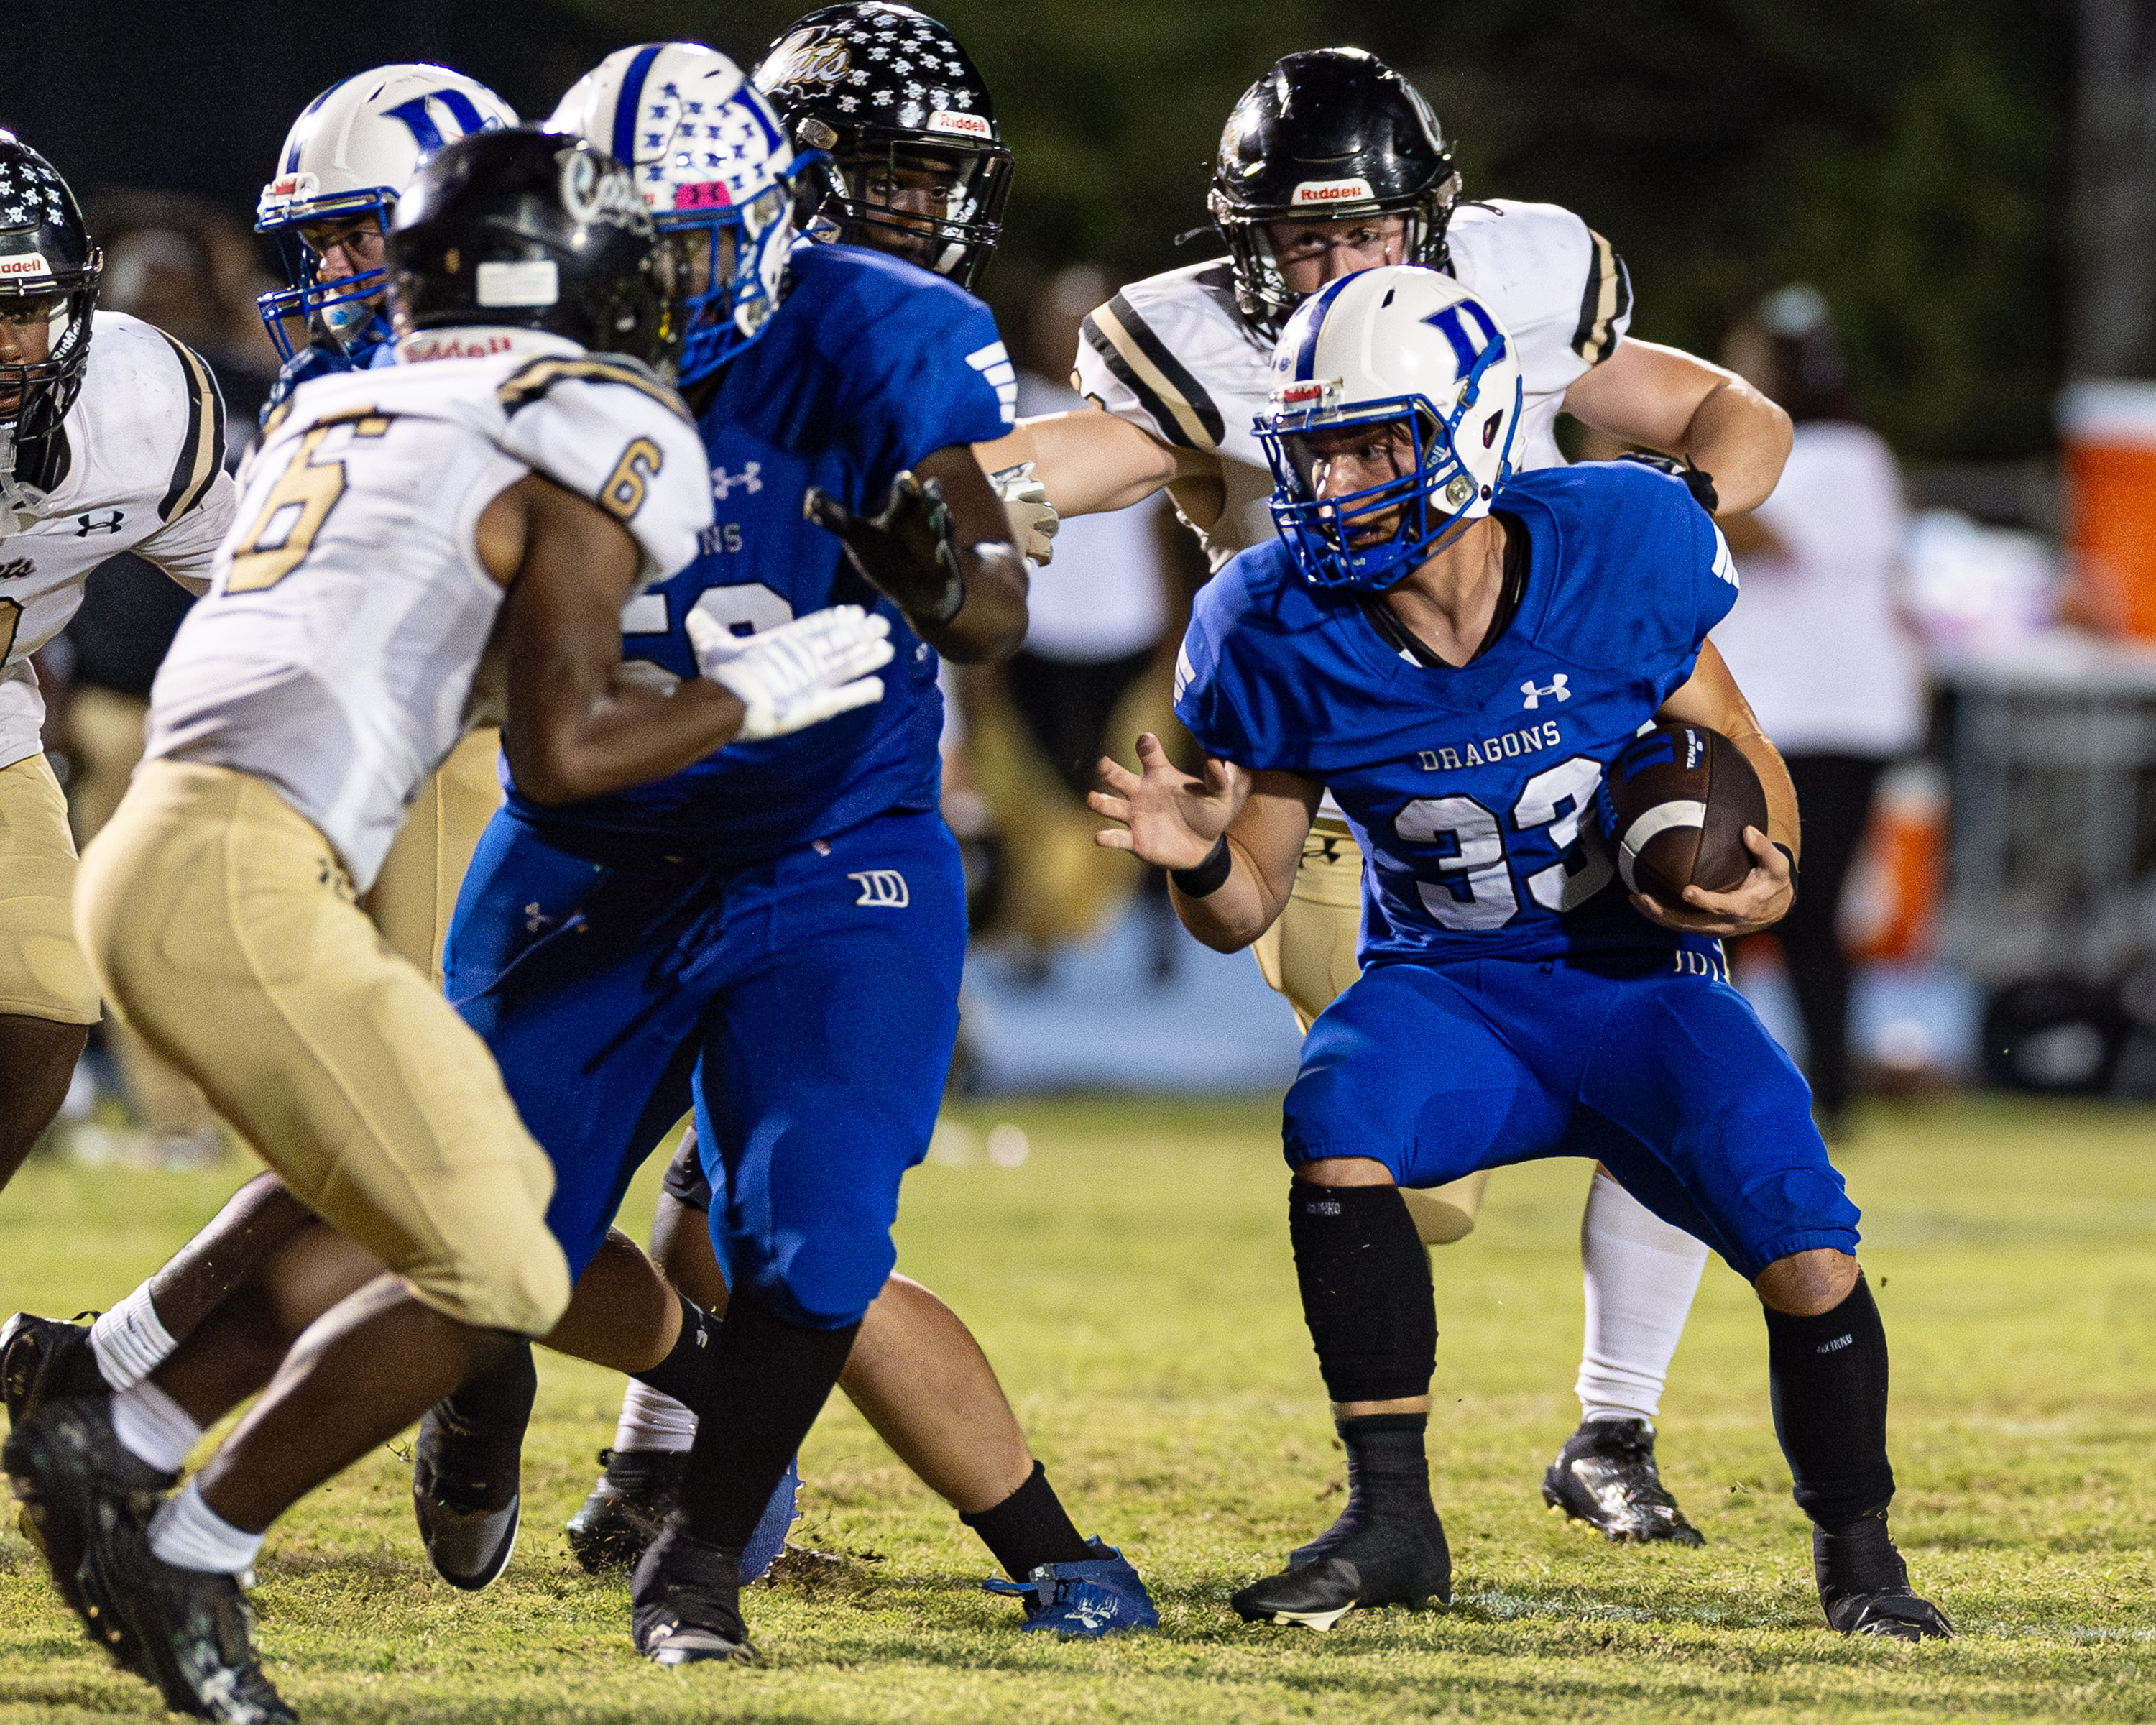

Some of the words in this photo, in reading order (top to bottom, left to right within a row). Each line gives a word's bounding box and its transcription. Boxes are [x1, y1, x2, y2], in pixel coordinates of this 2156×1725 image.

[940, 114, 986, 133] Riddell
[1301, 185, 1363, 201] Riddell
[598, 436, 664, 520] 6
[1417, 720, 1562, 771] DRAGONS
[1393, 755, 1616, 932] 33
